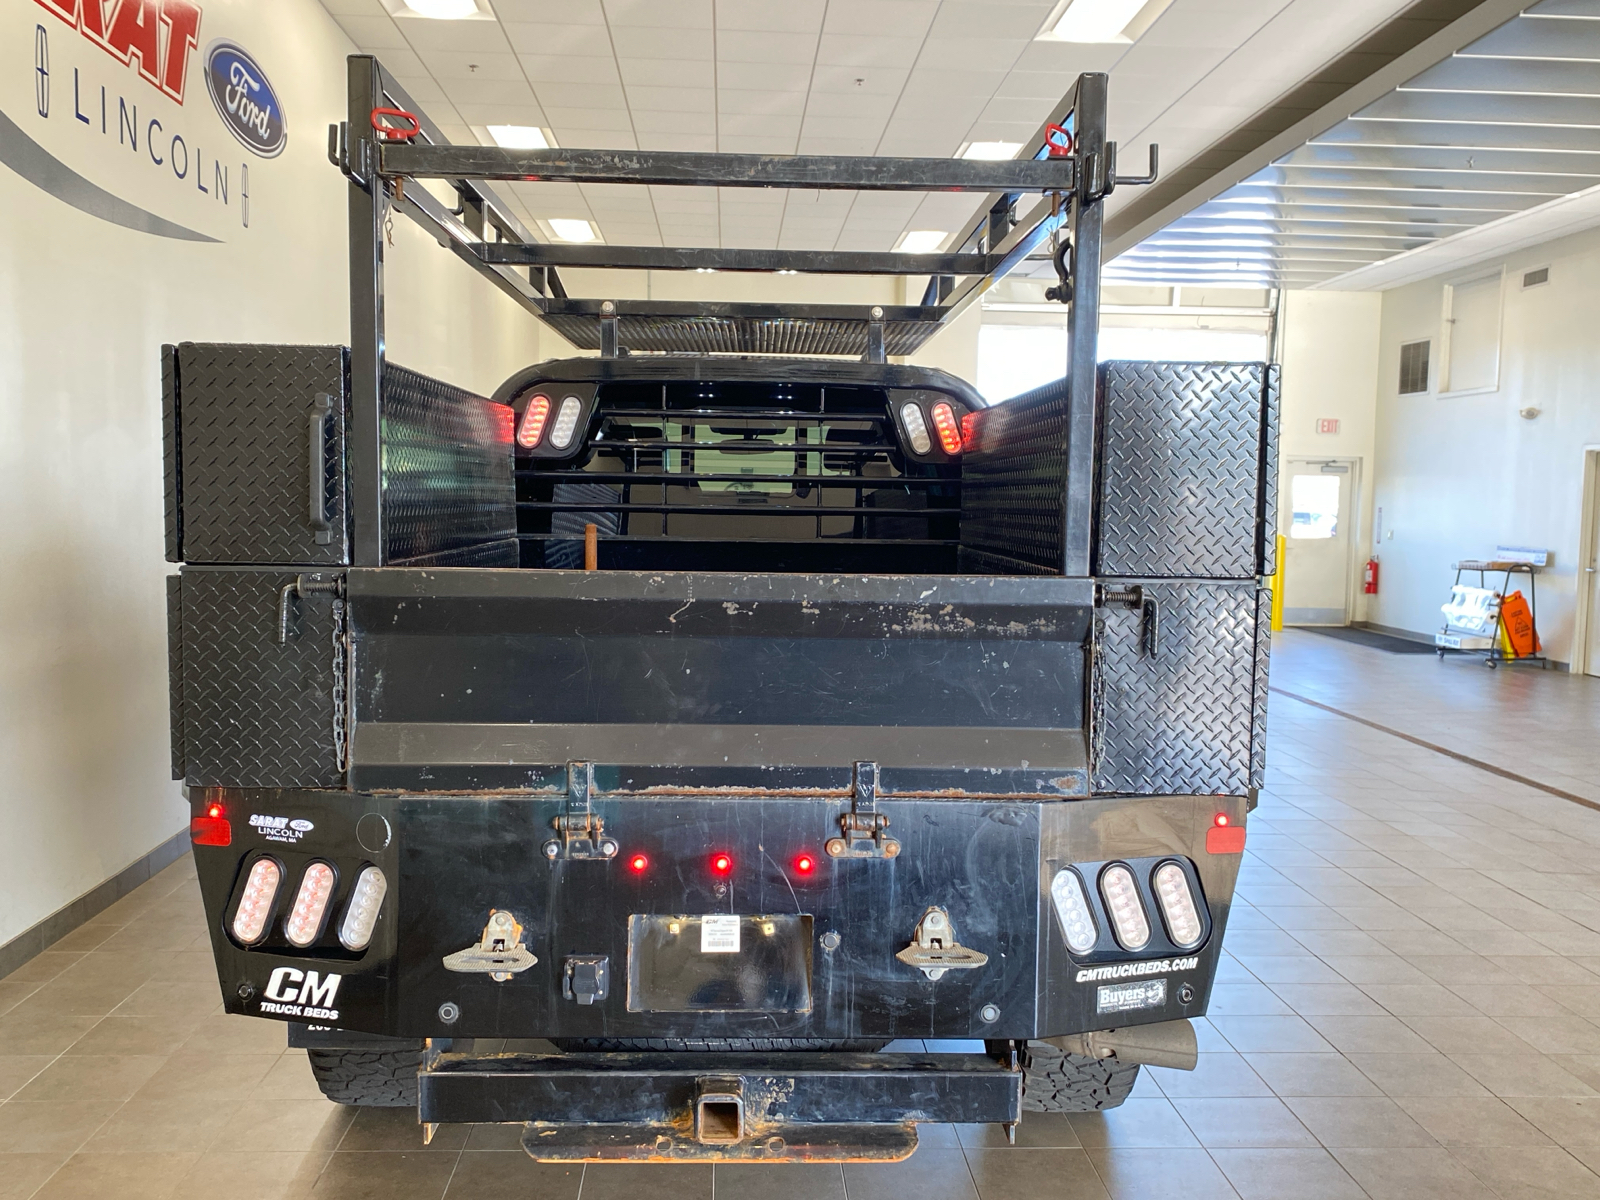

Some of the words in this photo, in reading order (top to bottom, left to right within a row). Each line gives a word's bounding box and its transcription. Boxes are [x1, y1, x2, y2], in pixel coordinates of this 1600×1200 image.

[226, 61, 271, 140] Ford
[73, 66, 229, 206] LINCOLN
[1321, 418, 1339, 434] EXIT
[249, 814, 289, 829] SARAT
[258, 827, 303, 839] LINCOLN
[1076, 957, 1199, 983] CMTRUCKBEDS.COM
[263, 967, 342, 1008] CM
[1100, 988, 1146, 1005] Buyers
[260, 1002, 303, 1016] TRUCK
[303, 1007, 339, 1020] BEDS
